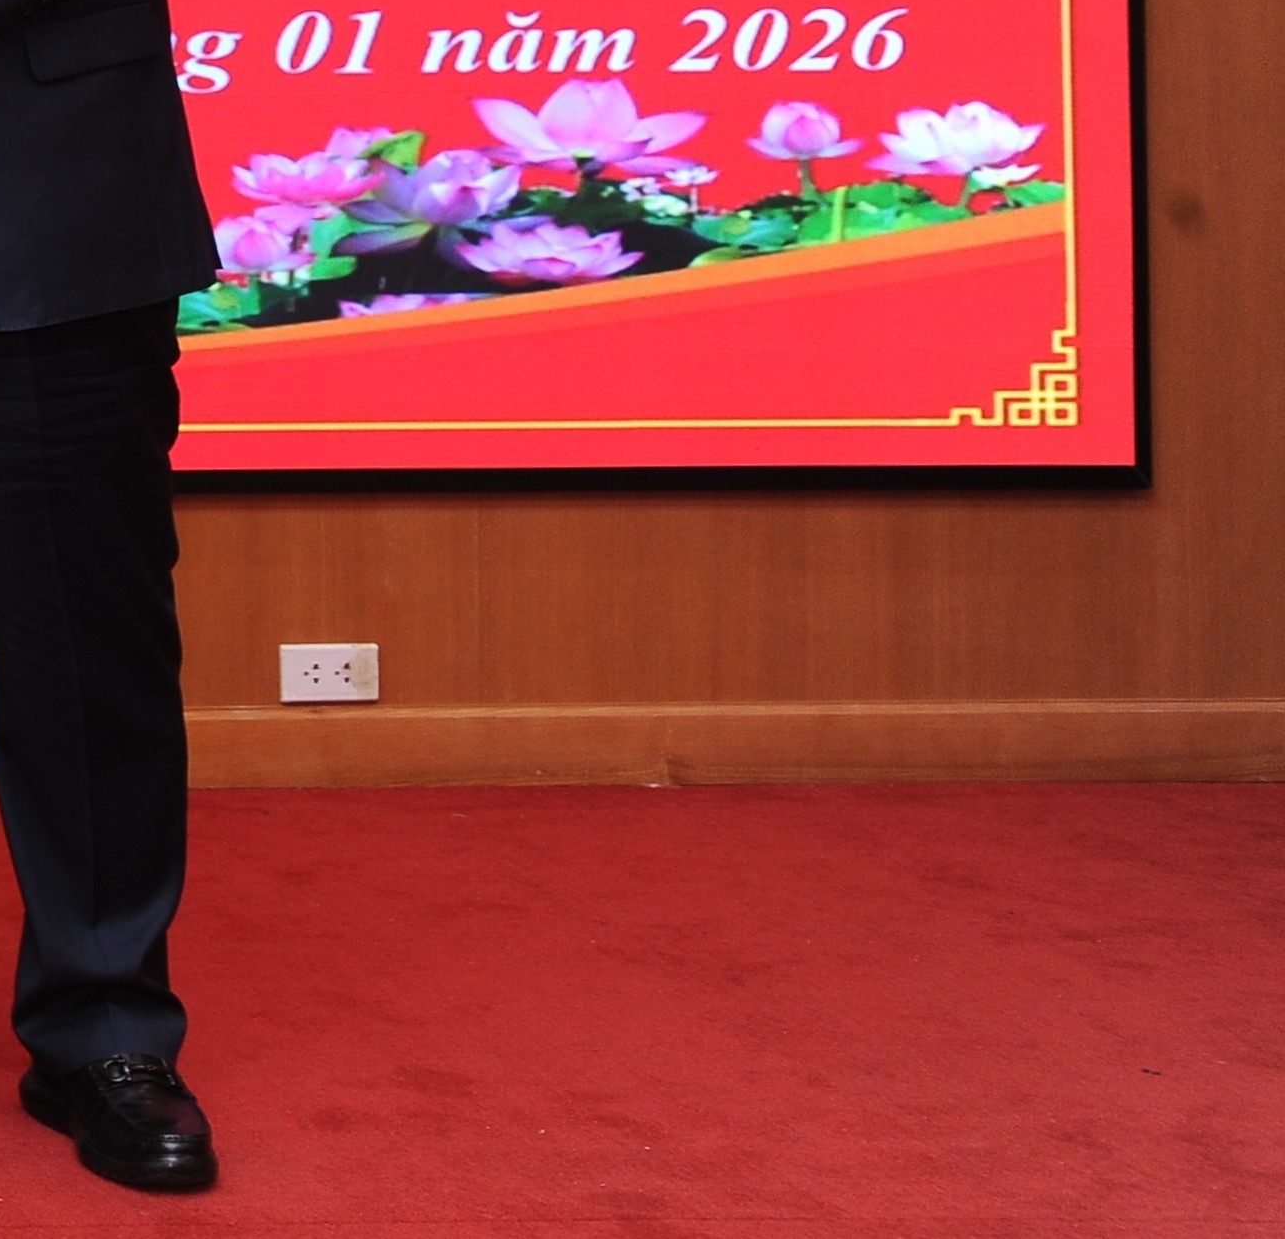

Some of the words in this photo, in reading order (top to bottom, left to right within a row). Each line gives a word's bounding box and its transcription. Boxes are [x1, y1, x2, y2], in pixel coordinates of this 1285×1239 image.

[275, 10, 383, 74] 01
[421, 11, 636, 74] năm
[668, 8, 909, 73] 2026
